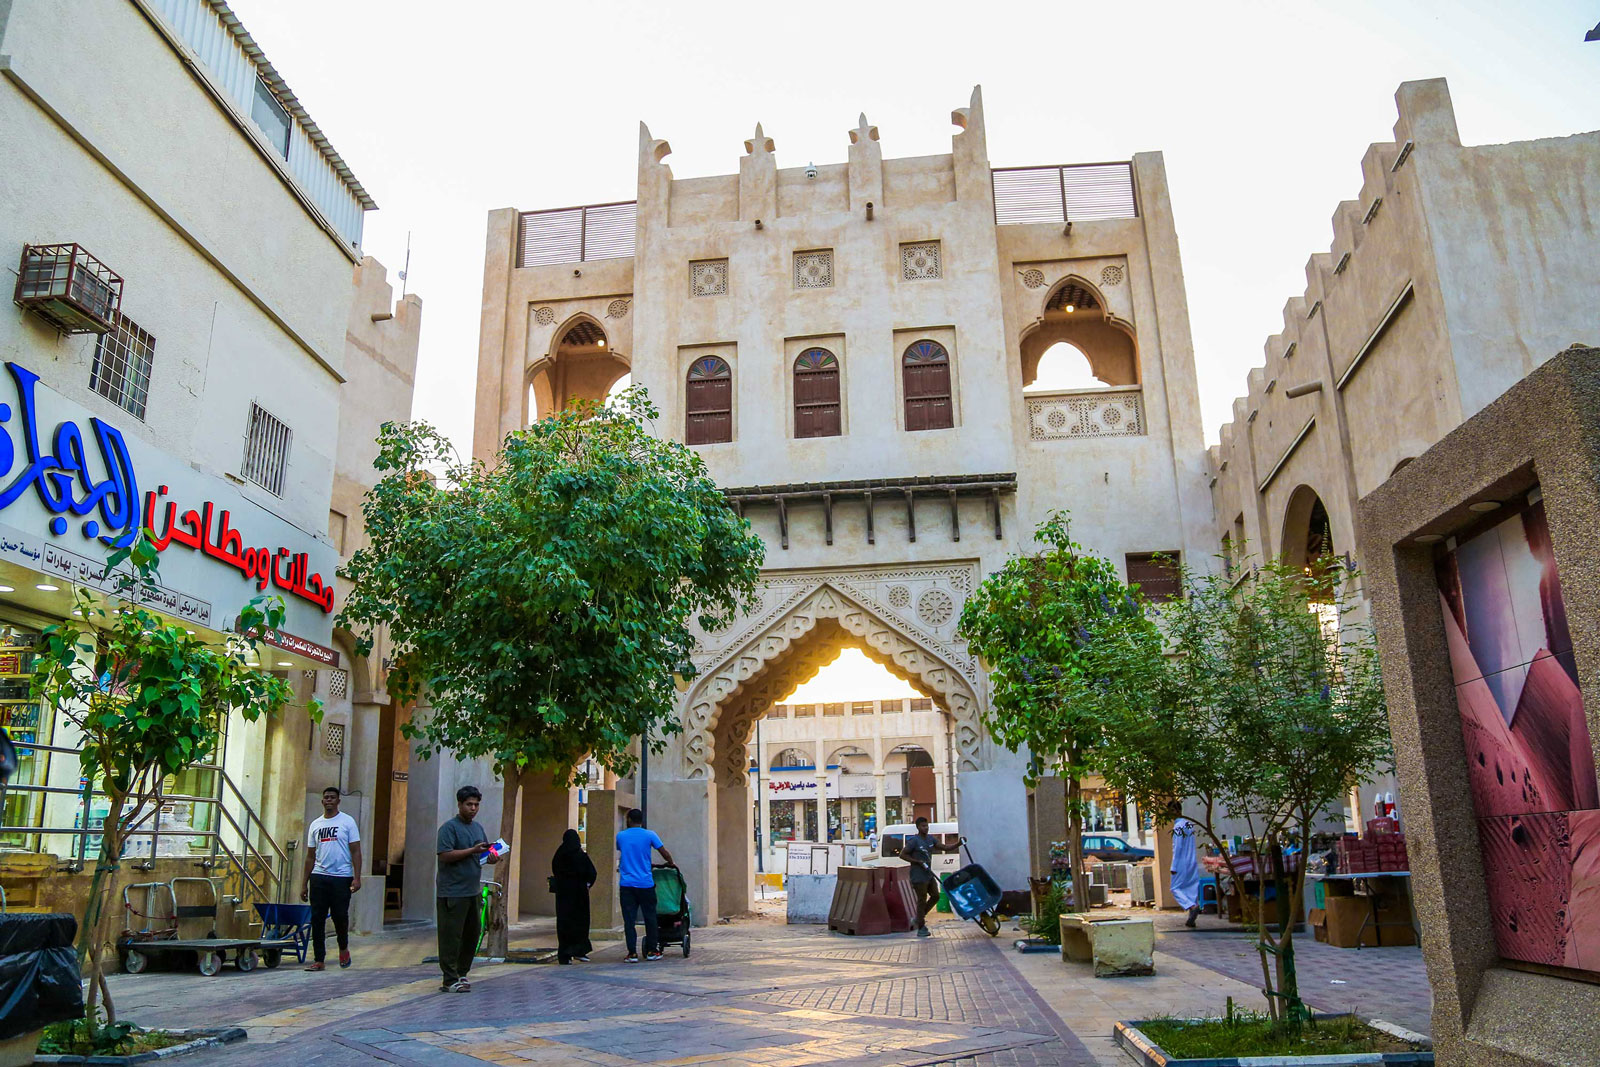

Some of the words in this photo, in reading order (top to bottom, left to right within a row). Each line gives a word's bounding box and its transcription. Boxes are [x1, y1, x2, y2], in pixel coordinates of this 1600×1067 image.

[1, 537, 18, 552] حسين
[143, 485, 270, 591] ومطاحن
[20, 541, 40, 561] مؤسسة
[46, 550, 72, 574] بهارات
[271, 547, 334, 613] محلات
[318, 826, 339, 840] NIKE
